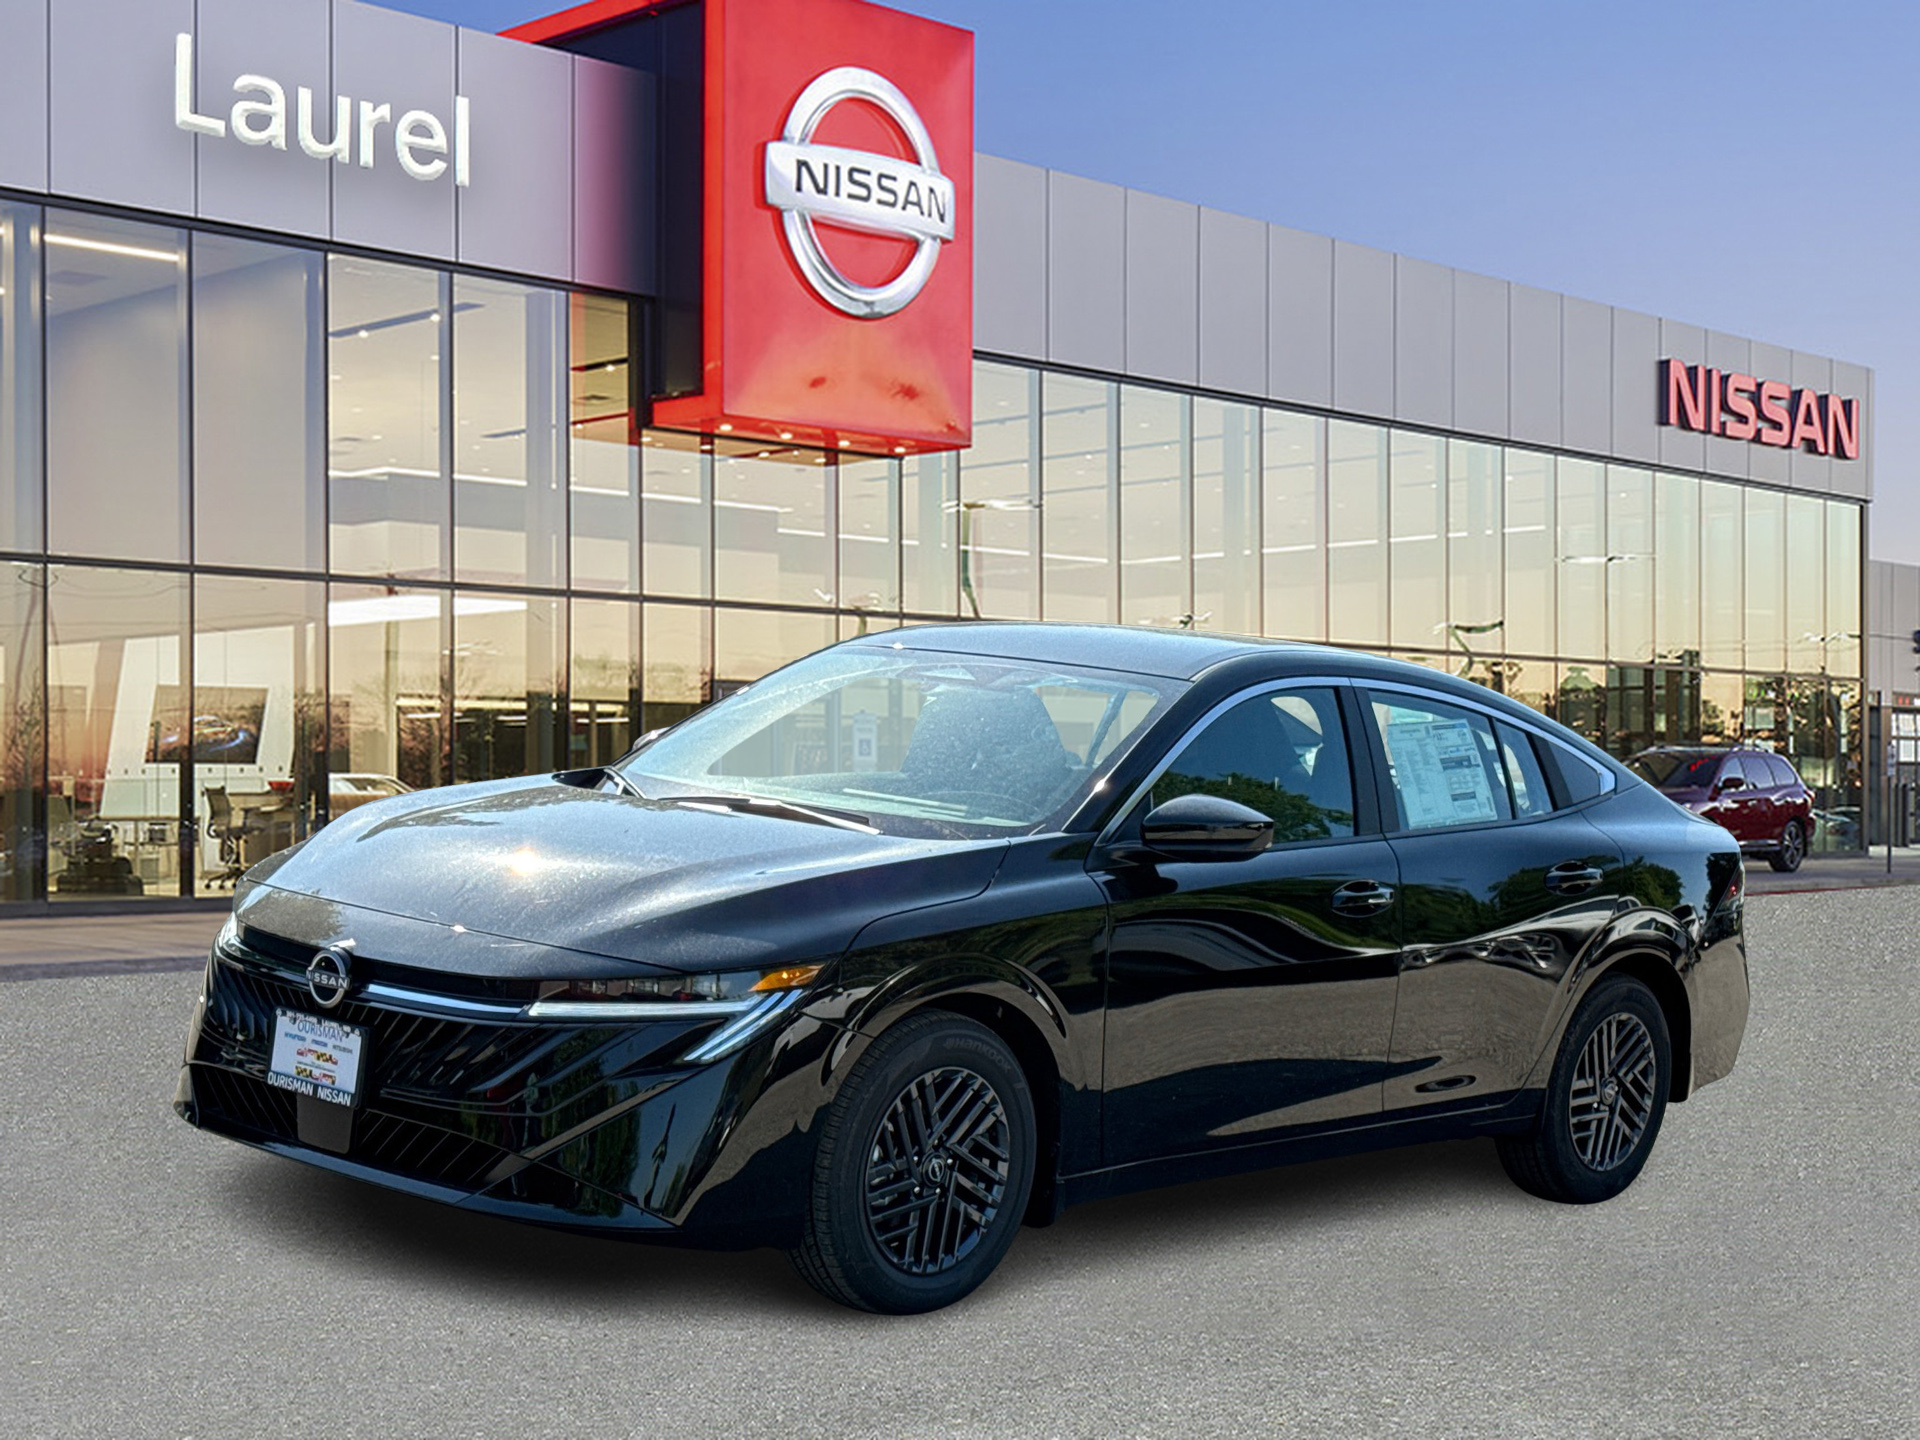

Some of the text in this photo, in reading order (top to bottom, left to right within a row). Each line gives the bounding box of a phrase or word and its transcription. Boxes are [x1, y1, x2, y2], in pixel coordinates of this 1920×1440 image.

[175, 32, 470, 187] Laurel
[795, 158, 946, 224] NISSAN
[1658, 358, 1860, 460] NISSAN
[306, 970, 348, 989] NISSAN
[297, 1020, 343, 1042] OURISMAN
[267, 1071, 352, 1107] OURISMAN NISSAN
